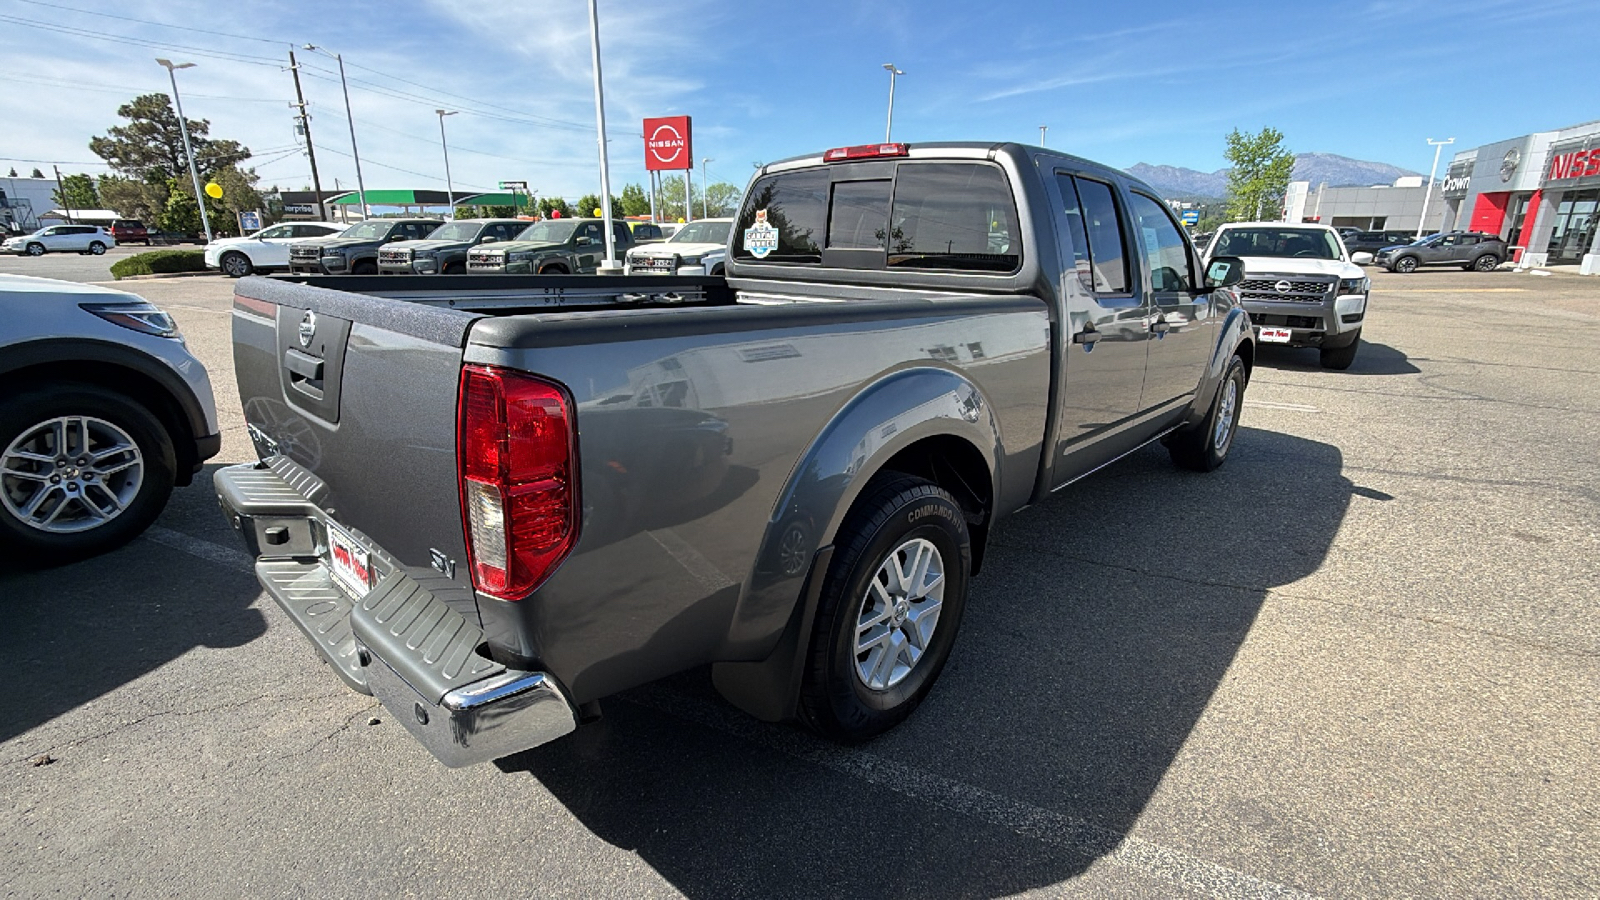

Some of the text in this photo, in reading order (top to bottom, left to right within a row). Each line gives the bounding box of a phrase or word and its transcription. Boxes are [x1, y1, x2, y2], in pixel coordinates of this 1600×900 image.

[648, 139, 684, 148] NISSAN
[1441, 174, 1471, 192] Crown
[283, 204, 313, 214] terprise
[907, 504, 953, 523] COMMANDO
